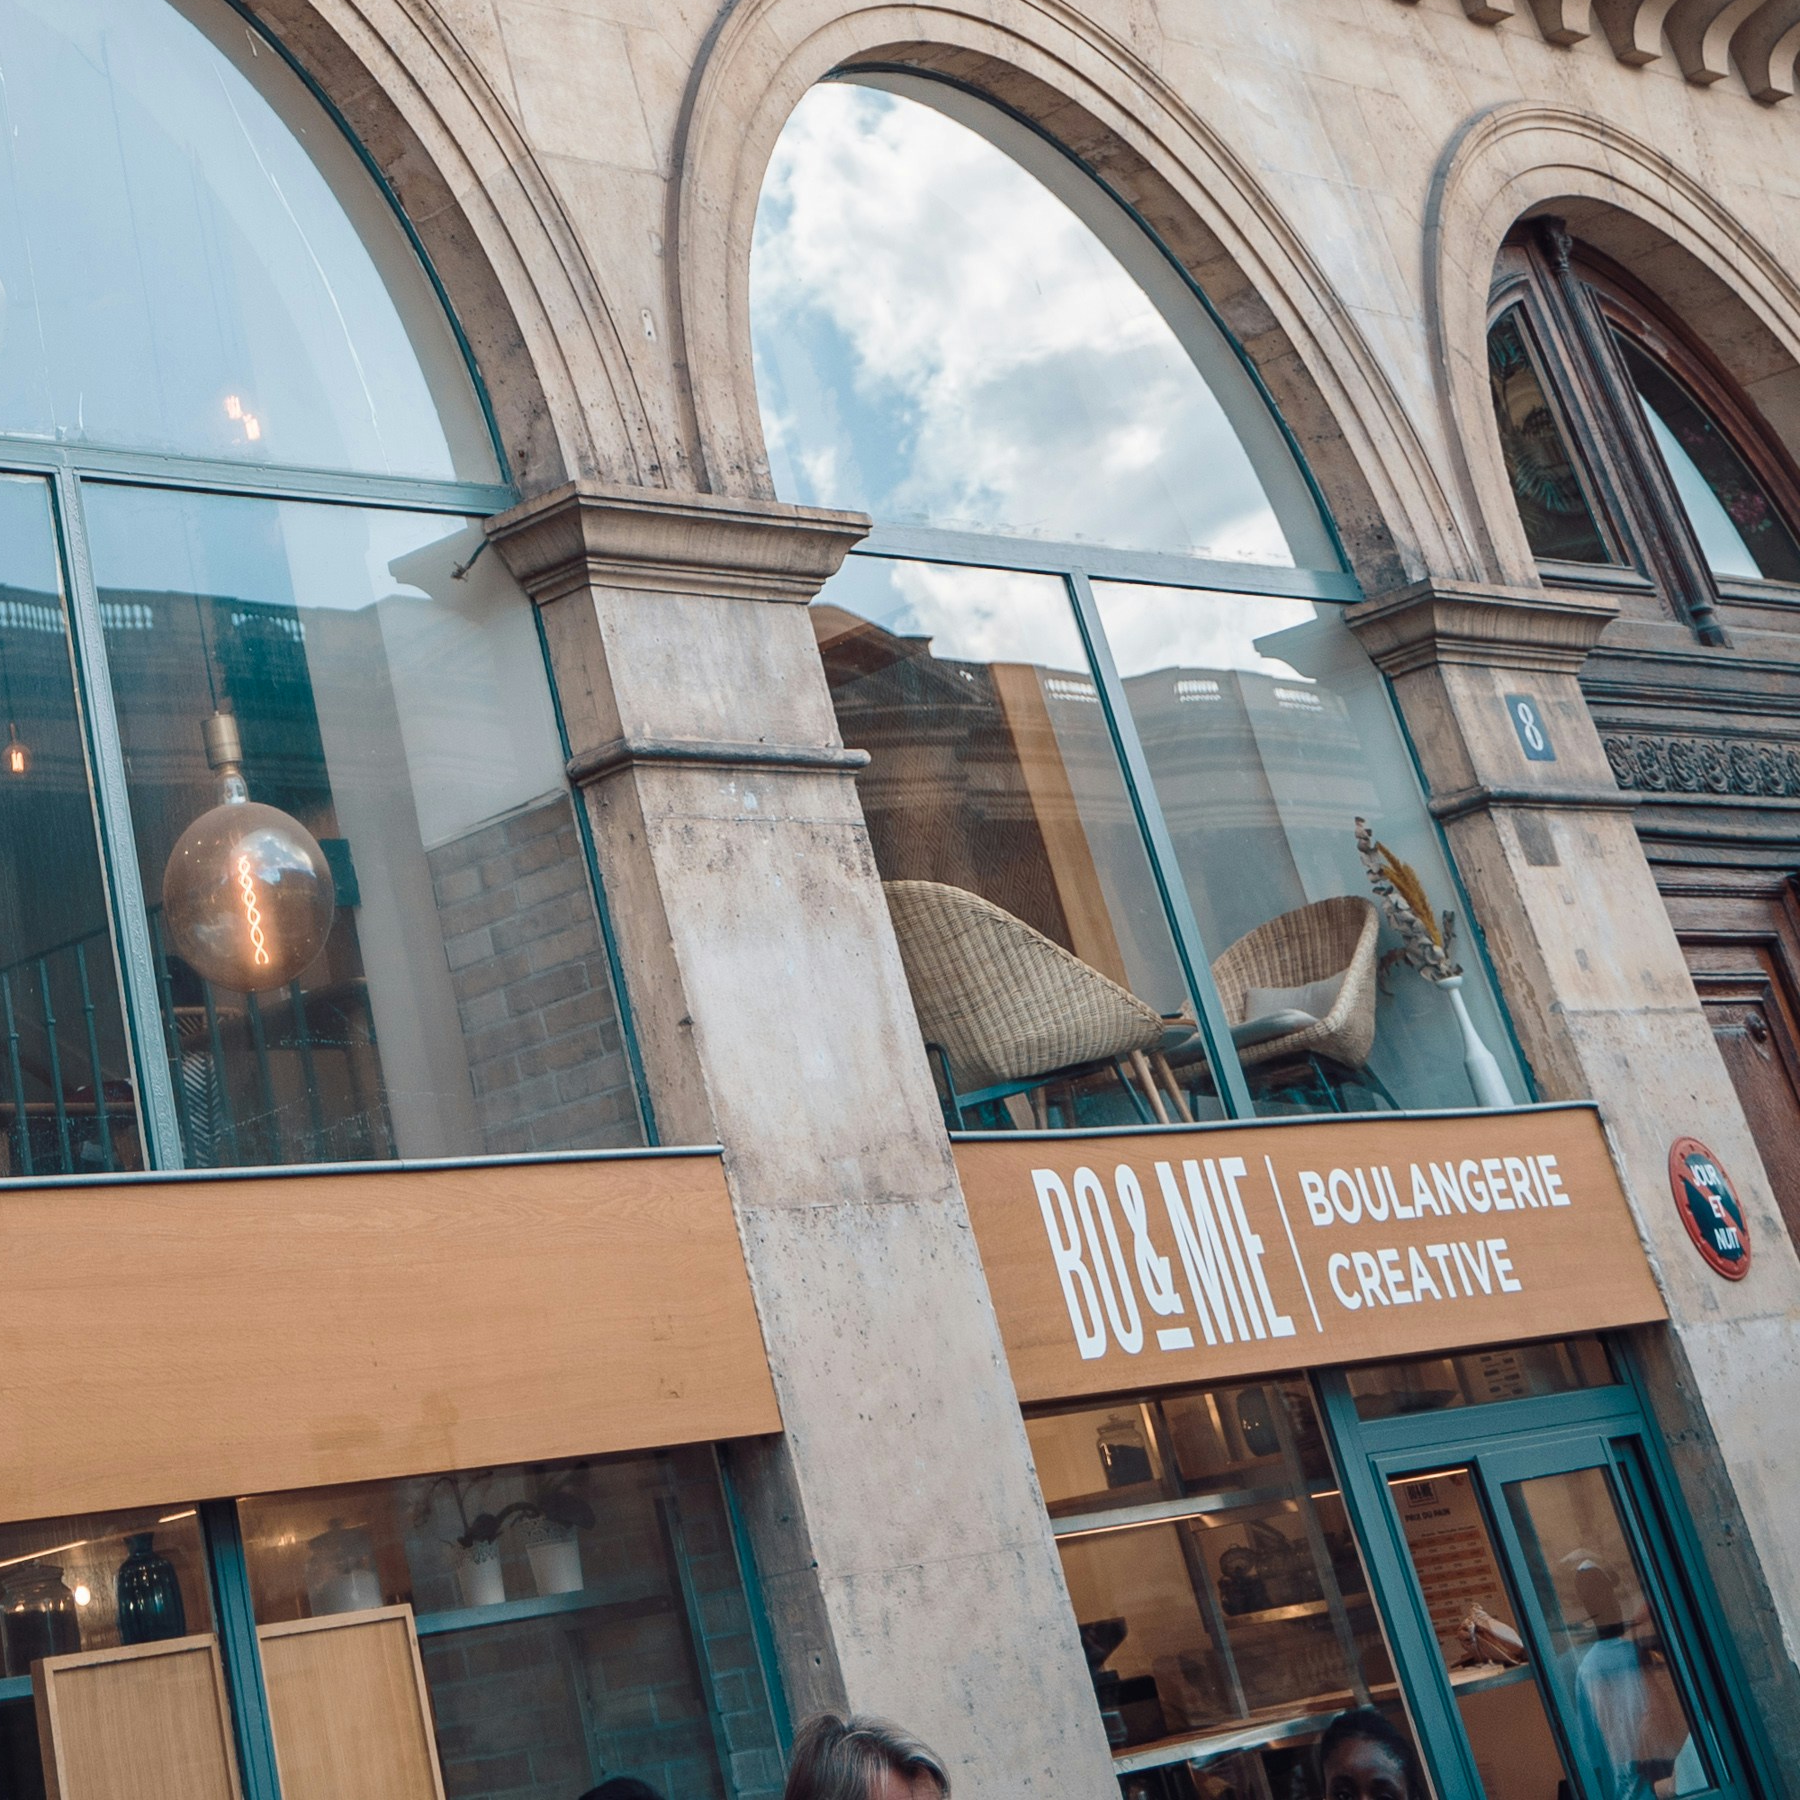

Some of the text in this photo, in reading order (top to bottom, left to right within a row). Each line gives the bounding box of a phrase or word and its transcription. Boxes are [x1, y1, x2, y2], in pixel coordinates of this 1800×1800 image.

[1517, 702, 1544, 751] 8
[1298, 1154, 1572, 1227] BOULANGERIE
[1690, 1164, 1721, 1186] JOUR
[1708, 1195, 1725, 1218] ET
[1030, 1156, 1297, 1360] BO&MIE
[1714, 1226, 1740, 1251] NUIT
[1327, 1238, 1523, 1311] CREATIVE
